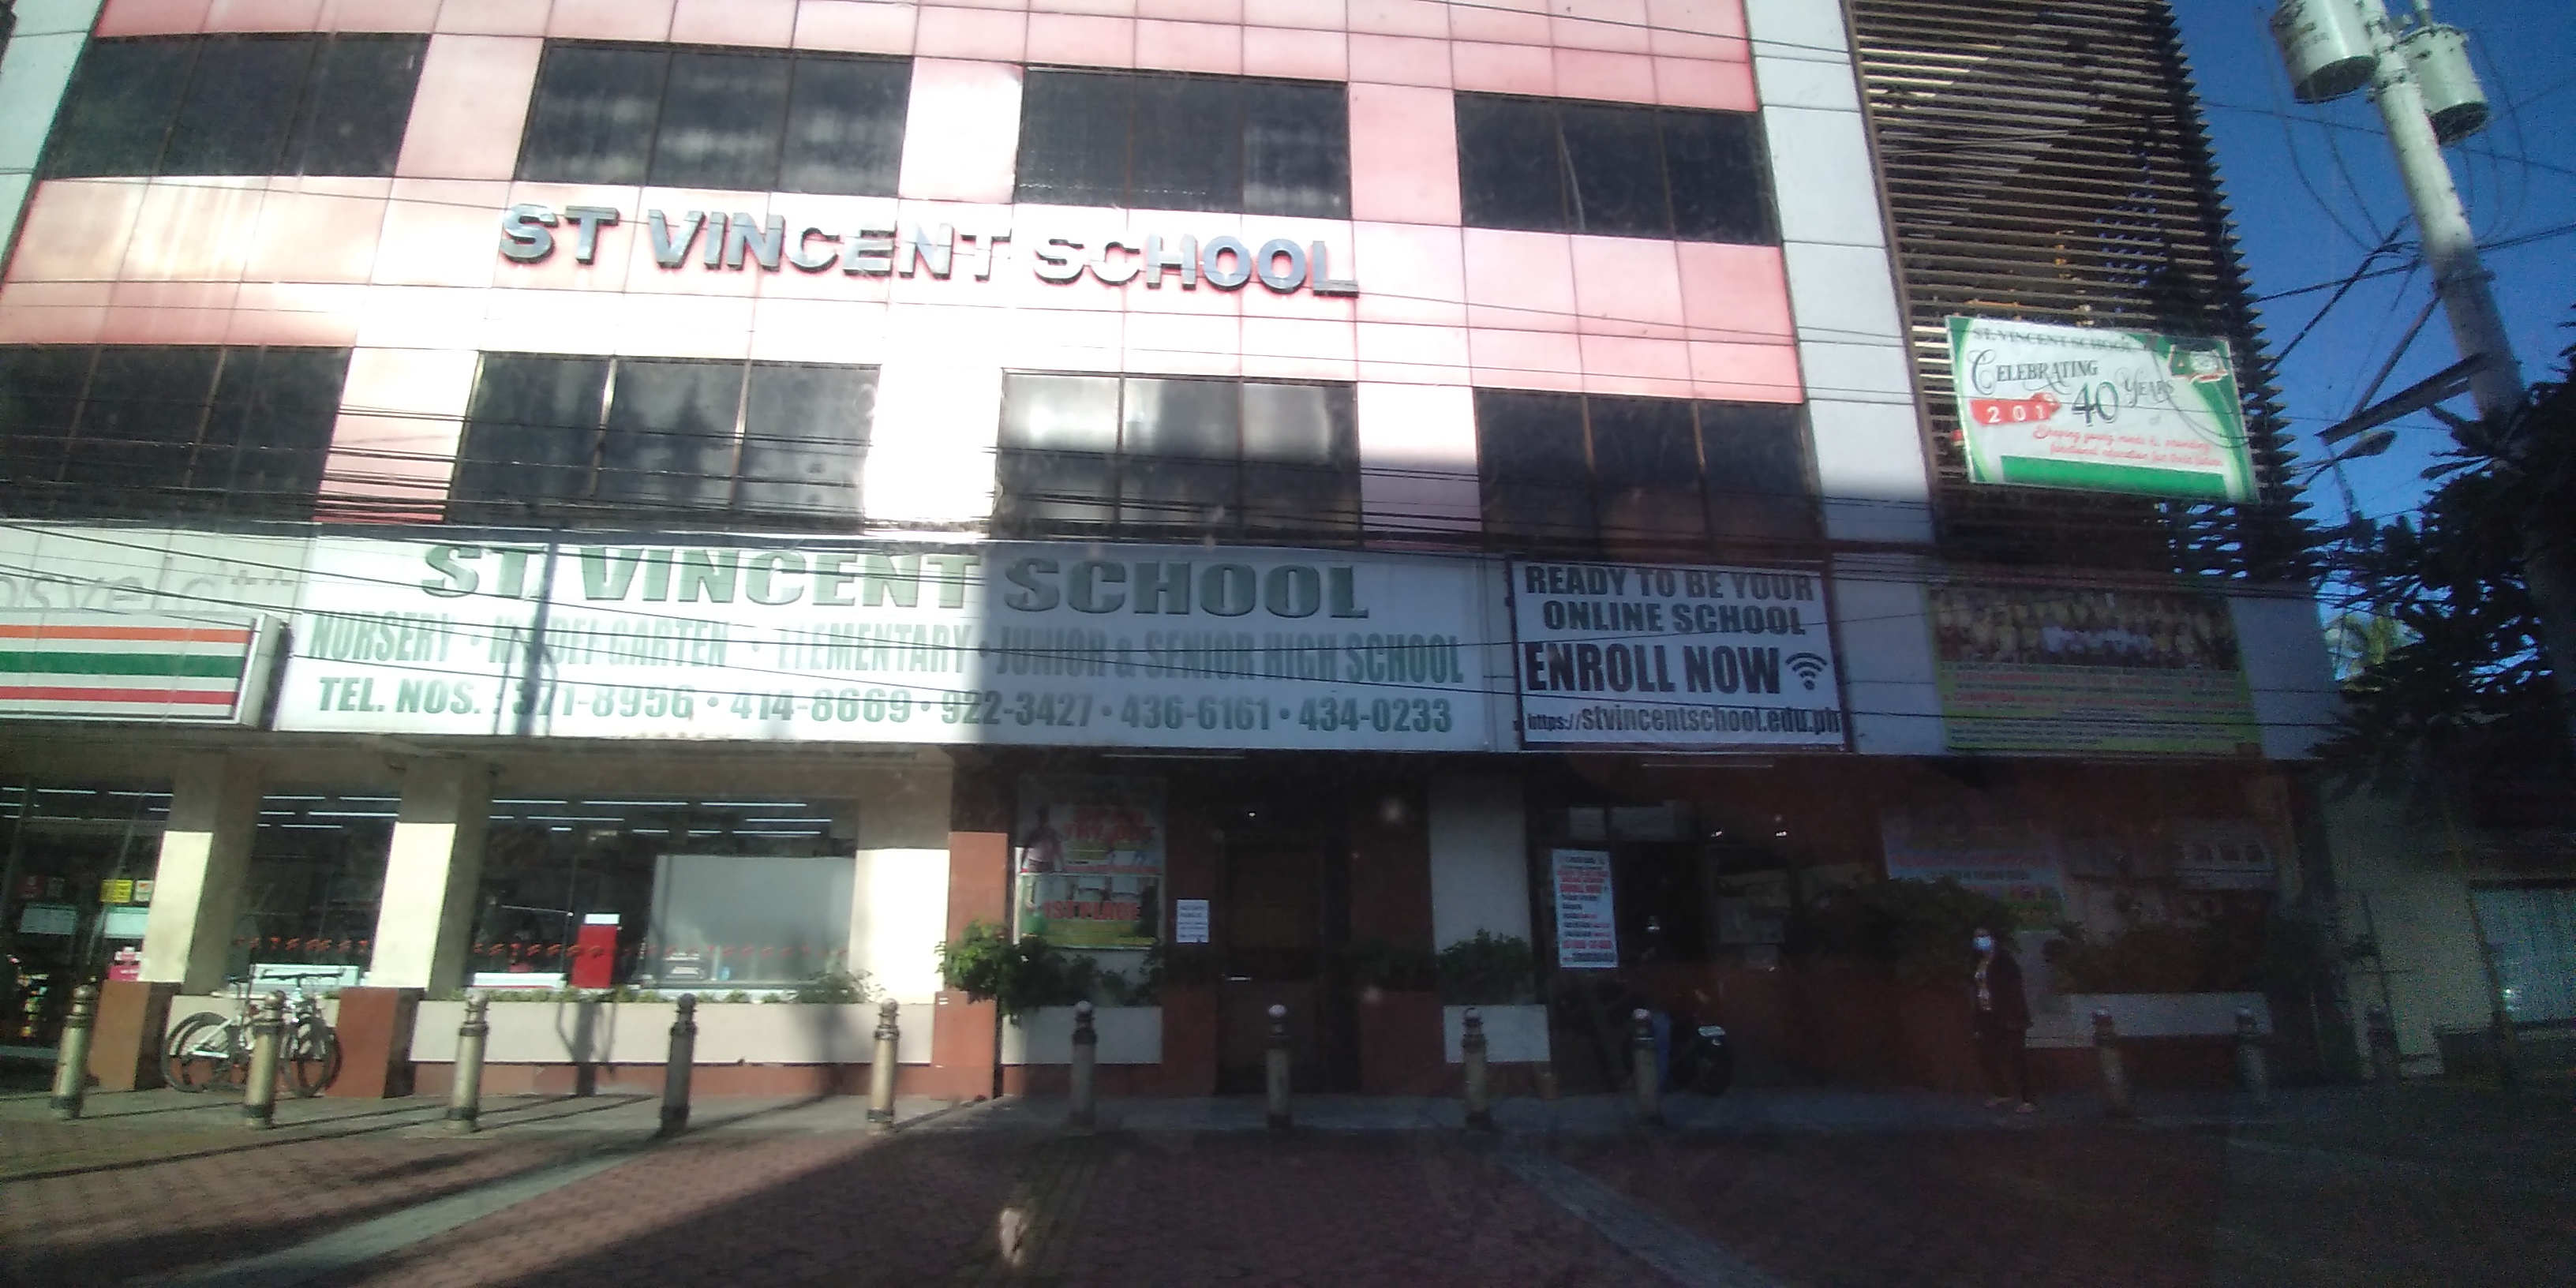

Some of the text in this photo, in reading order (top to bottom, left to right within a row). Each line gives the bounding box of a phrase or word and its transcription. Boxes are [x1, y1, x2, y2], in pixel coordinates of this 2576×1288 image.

[500, 203, 1360, 298] ST VINCENT SCHOOL
[2072, 381, 2118, 427] 40
[421, 544, 1369, 619] ST VINCENT SCHOOL
[1526, 565, 1814, 601] READY TO BE YOUR
[1544, 600, 1806, 635] ONLINE SCHOOL
[308, 611, 458, 662] NURSERY
[777, 622, 972, 673] ELEMENTARY
[997, 626, 1106, 677] JUNIOR
[1115, 635, 1136, 678] &
[1145, 631, 1256, 680] SENIOR
[1264, 632, 1338, 683] HIGH
[1346, 634, 1465, 684] SCHOOL
[1525, 642, 1780, 694] ENROLL NOW
[318, 677, 384, 712] TEL.
[397, 679, 481, 715] NOS.
[730, 687, 912, 724] 414-8669
[942, 690, 1095, 728] 922-3427
[1121, 695, 1271, 731] 436-6161
[1299, 698, 1454, 733] 434-0233
